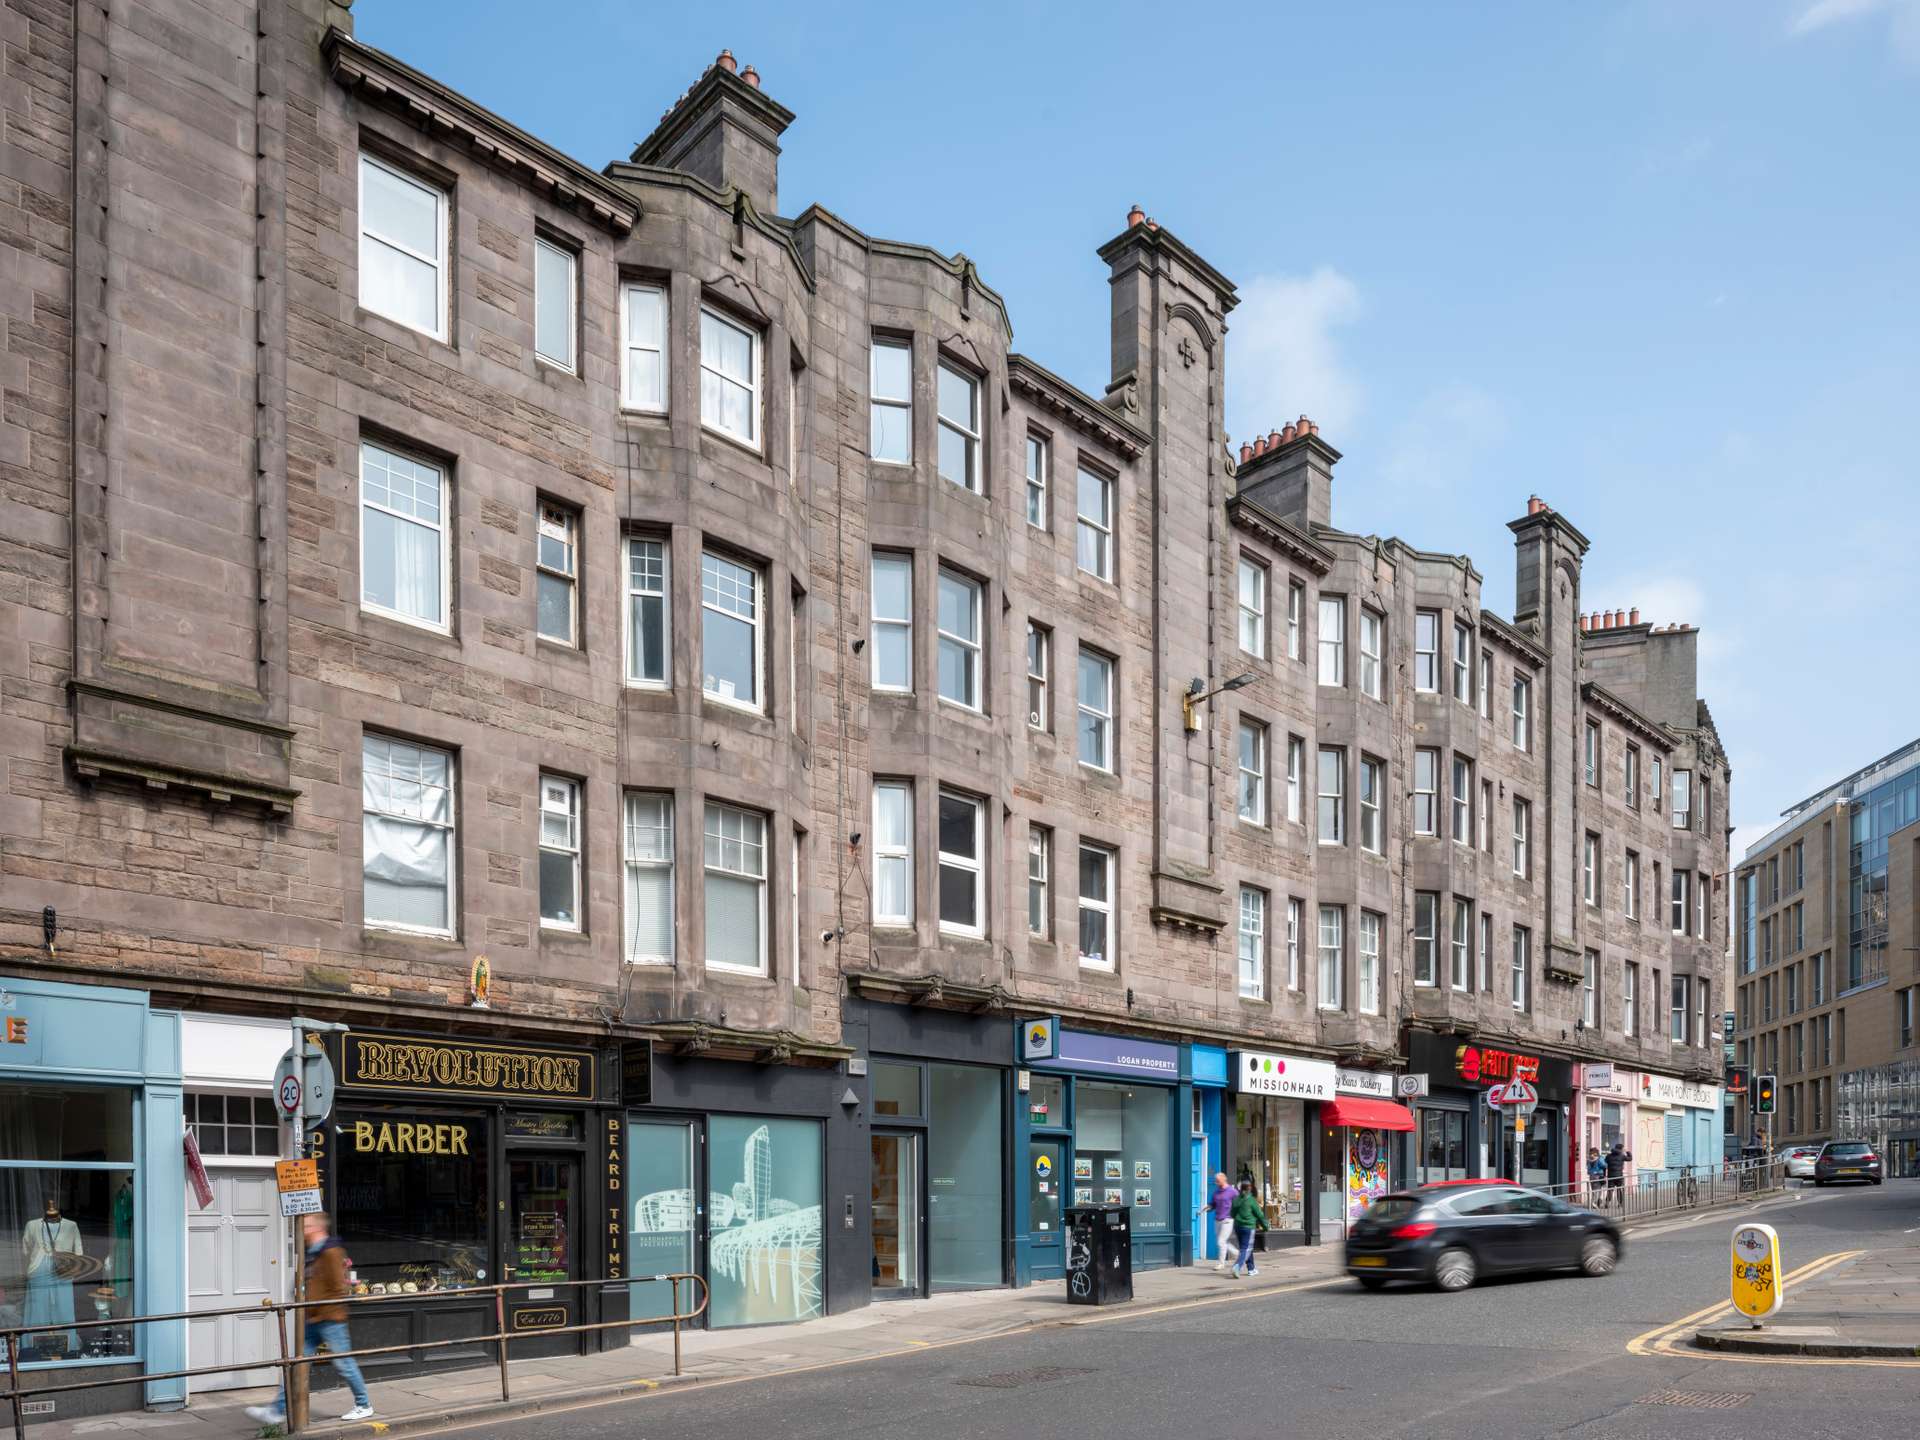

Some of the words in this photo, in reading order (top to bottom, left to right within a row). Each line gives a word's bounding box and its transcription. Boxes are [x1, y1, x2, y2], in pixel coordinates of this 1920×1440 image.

[357, 1041, 581, 1092] REVOLUTION
[1117, 1056, 1140, 1065] LOGAN
[1142, 1058, 1175, 1069] PROPERTY
[283, 1086, 298, 1101] 20
[1250, 1078, 1323, 1095] MISSIONHAIR
[1360, 1076, 1382, 1093] Bakery
[355, 1121, 469, 1155] BARBER
[608, 1119, 620, 1190] BEARD
[609, 1208, 620, 1279] TRIMS
